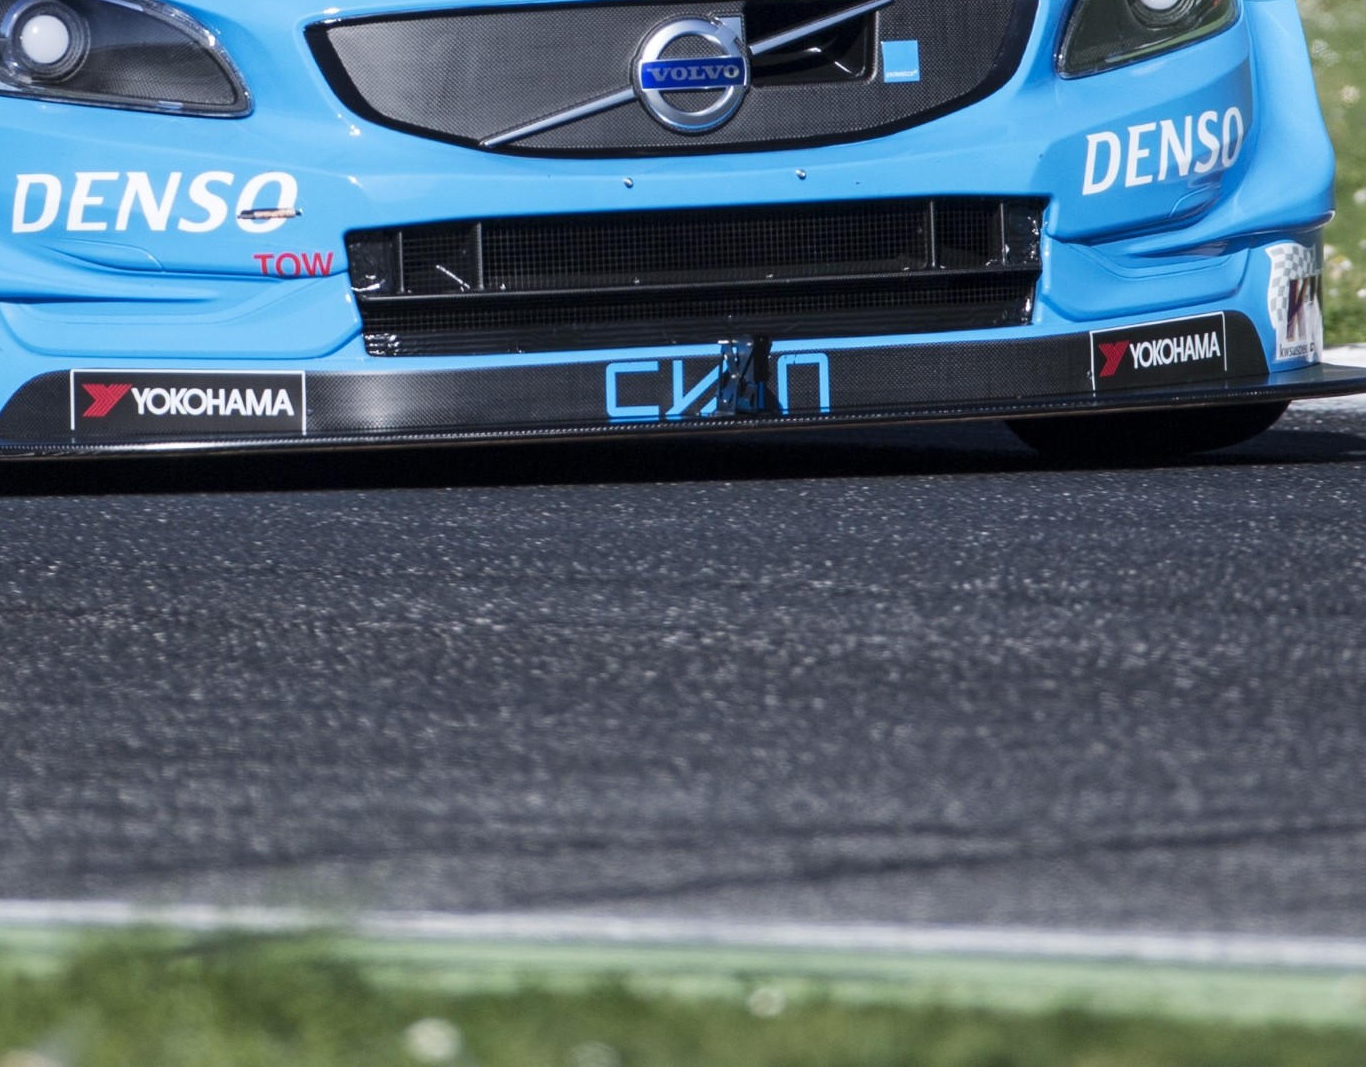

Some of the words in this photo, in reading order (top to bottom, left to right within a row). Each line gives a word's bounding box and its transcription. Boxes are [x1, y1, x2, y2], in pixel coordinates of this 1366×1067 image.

[646, 64, 740, 82] VOLVO
[1081, 106, 1244, 196] DENSO
[11, 171, 298, 233] DENSO
[252, 251, 333, 277] TOW
[1129, 331, 1221, 370] YOKOHAMA
[130, 384, 295, 417] YOKOHAMA
[605, 352, 830, 420] CYN
